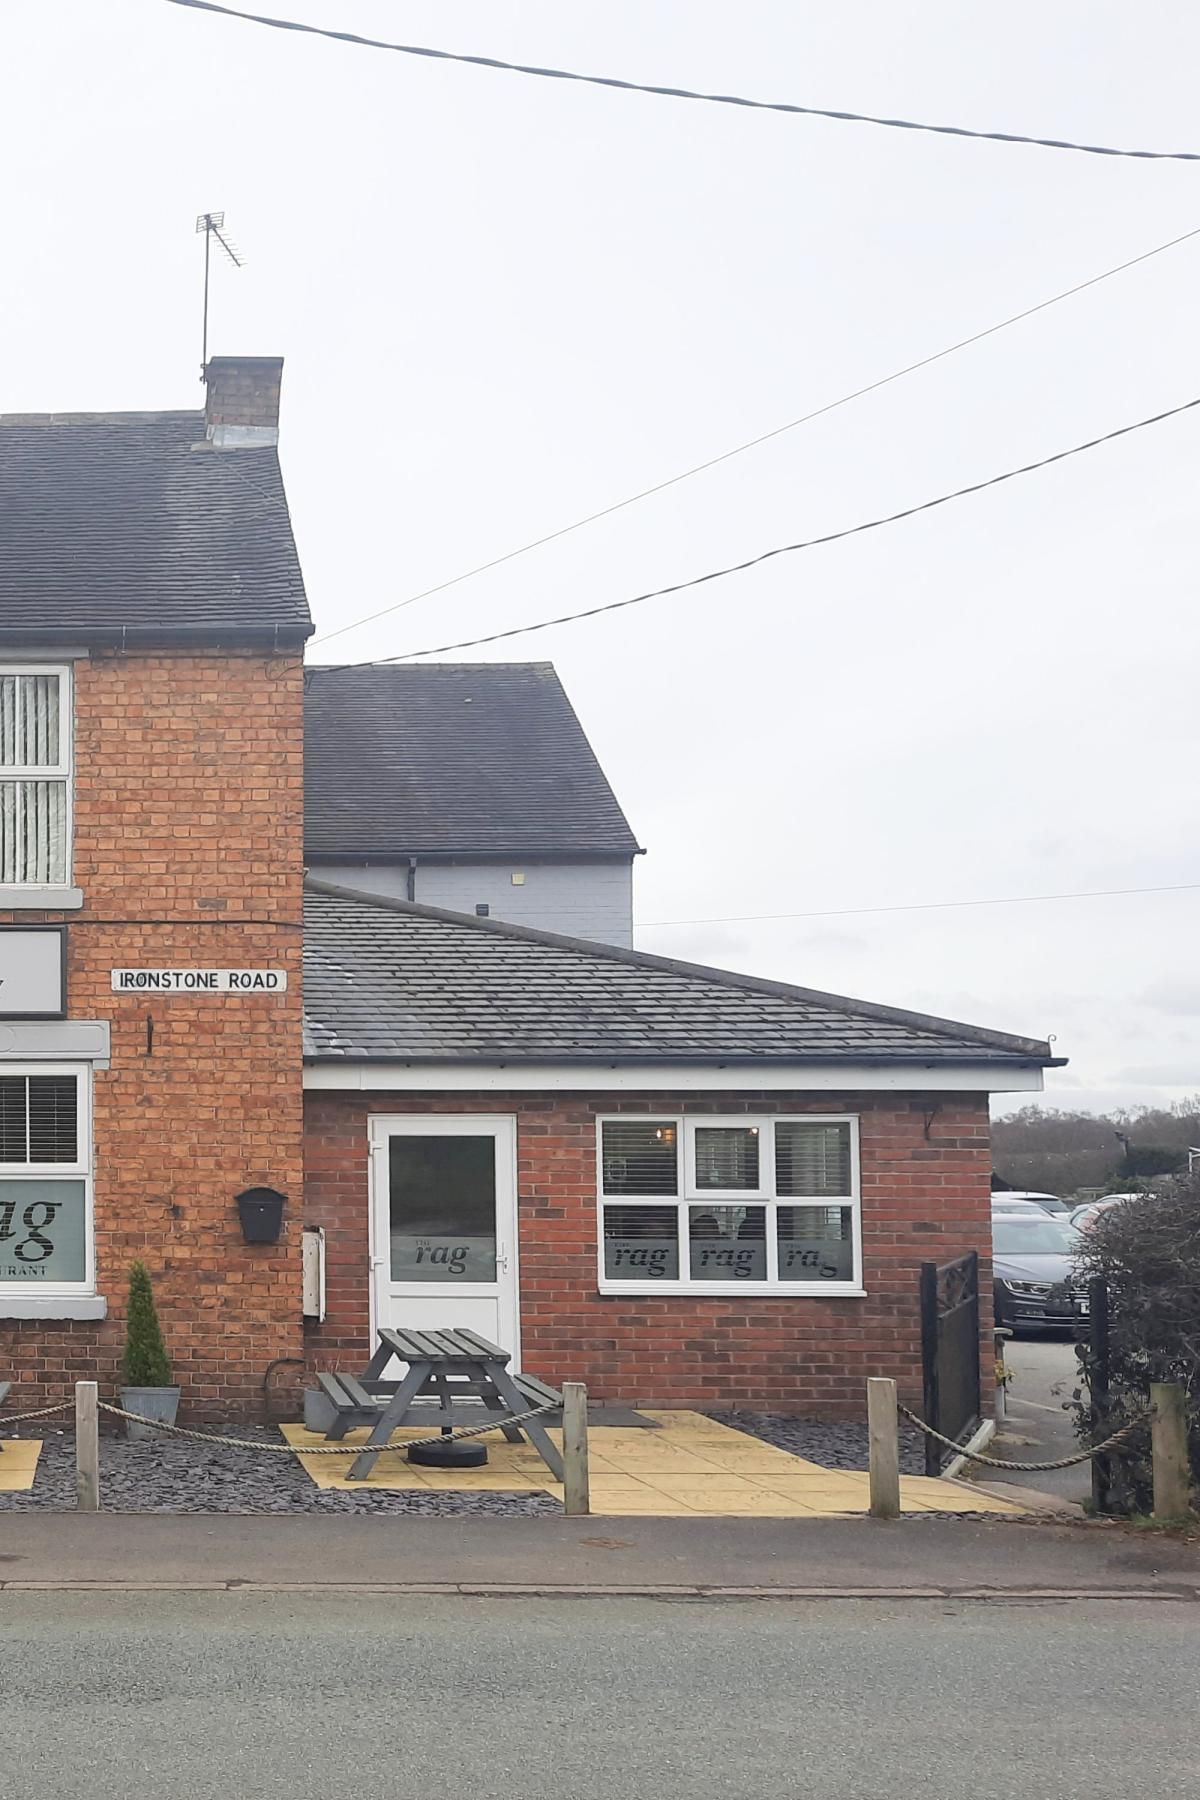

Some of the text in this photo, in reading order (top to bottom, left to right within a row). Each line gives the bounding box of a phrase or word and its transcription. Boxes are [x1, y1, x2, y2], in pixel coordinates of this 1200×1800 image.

[119, 971, 278, 989] IRONSTONE ROAD
[415, 1245, 470, 1275] rag
[614, 1249, 670, 1277] rag
